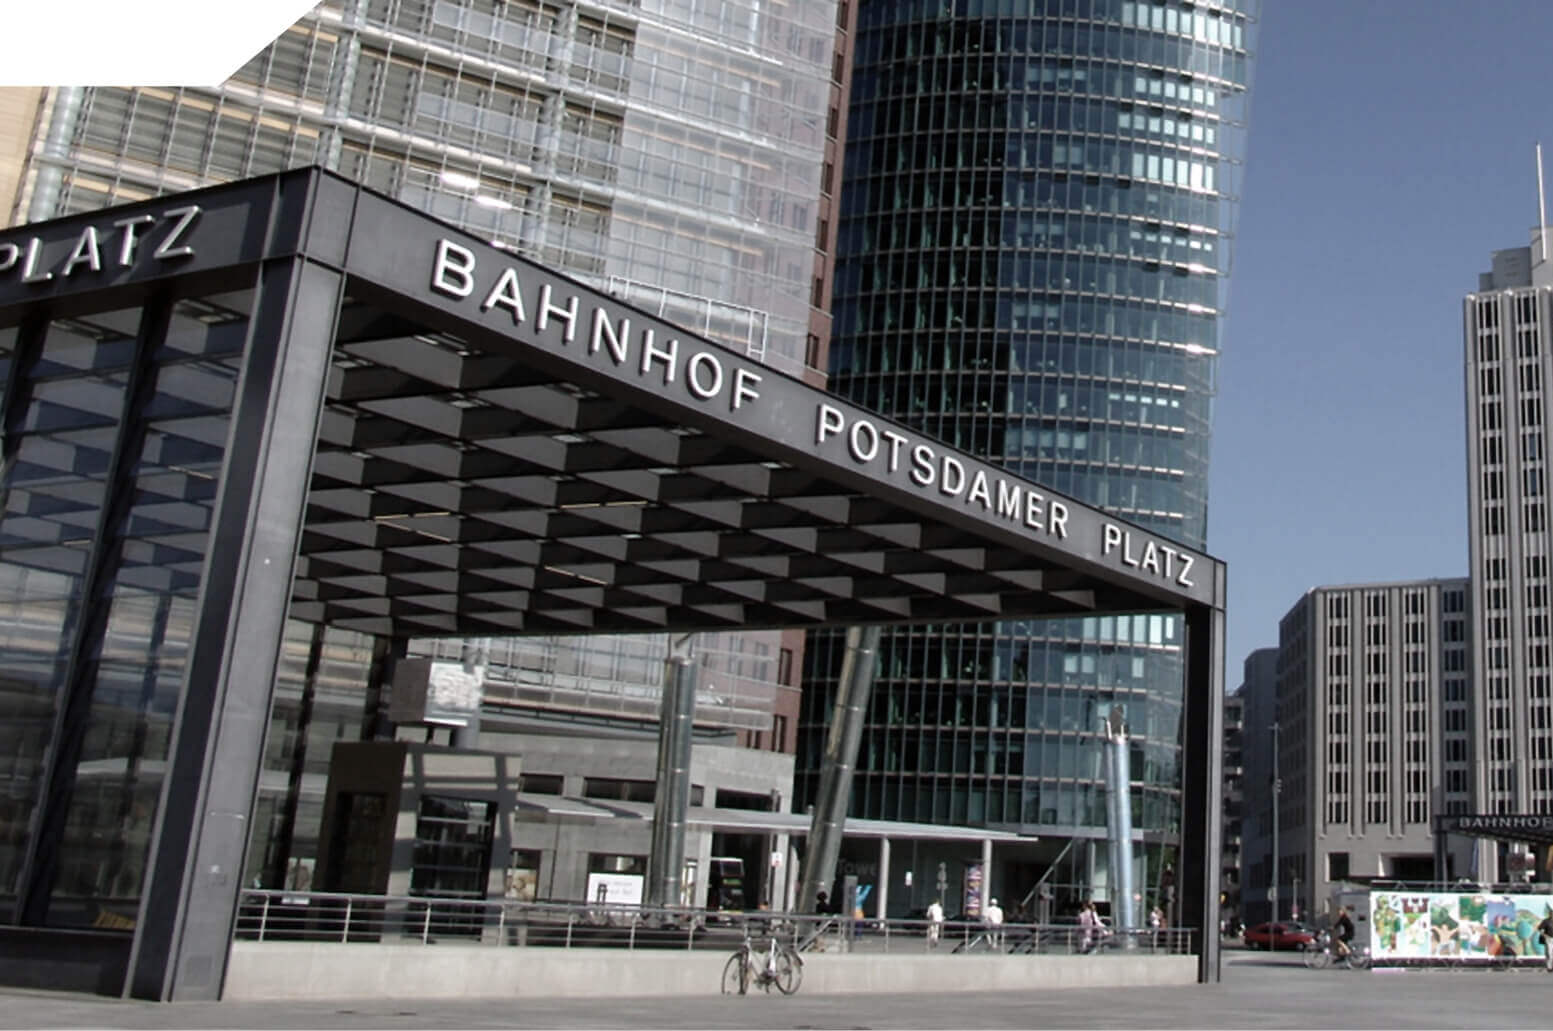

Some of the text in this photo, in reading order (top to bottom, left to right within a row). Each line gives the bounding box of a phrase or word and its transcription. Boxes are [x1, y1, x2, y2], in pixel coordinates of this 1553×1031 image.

[432, 238, 1194, 587] BAHNHOF POTSDAMER PLATZ
[1459, 815, 1553, 829] BAHNHOF
